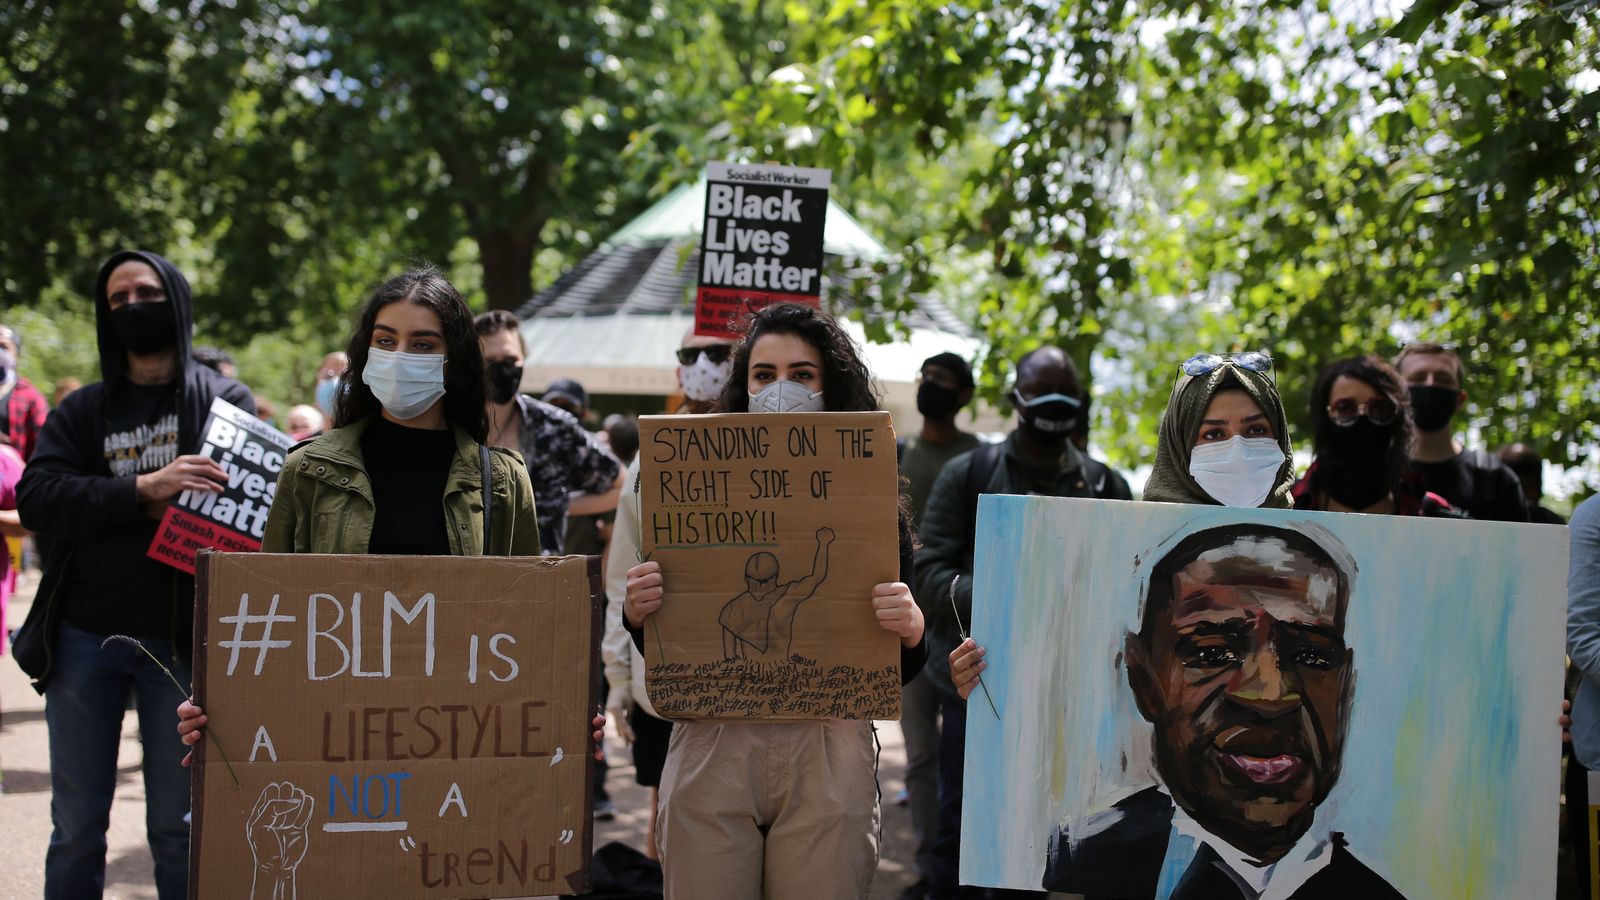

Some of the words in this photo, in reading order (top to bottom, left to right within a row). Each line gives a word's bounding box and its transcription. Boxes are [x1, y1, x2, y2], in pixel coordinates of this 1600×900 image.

[727, 168, 770, 183] Socialist
[771, 171, 810, 186] Worker
[708, 184, 802, 223] Black
[705, 217, 790, 255] Lives
[702, 251, 817, 291] Matter
[653, 426, 770, 463] STANDING
[788, 425, 817, 457] ON
[835, 428, 874, 459] THE
[660, 470, 731, 503] RIGHT
[750, 469, 792, 499] SIDE
[810, 470, 832, 500] OF
[163, 526, 179, 543] by
[170, 513, 215, 540] Smash
[653, 509, 776, 544] HISTORY!!
[217, 591, 435, 681] #BLM
[468, 633, 519, 683] IS
[649, 663, 691, 677] #BLM
[651, 683, 682, 702] #BLM
[683, 680, 720, 697] #BLM
[248, 725, 277, 764] A
[322, 701, 563, 767] LIFESTYLE,
[328, 771, 413, 819] NOT
[438, 783, 467, 817] A
